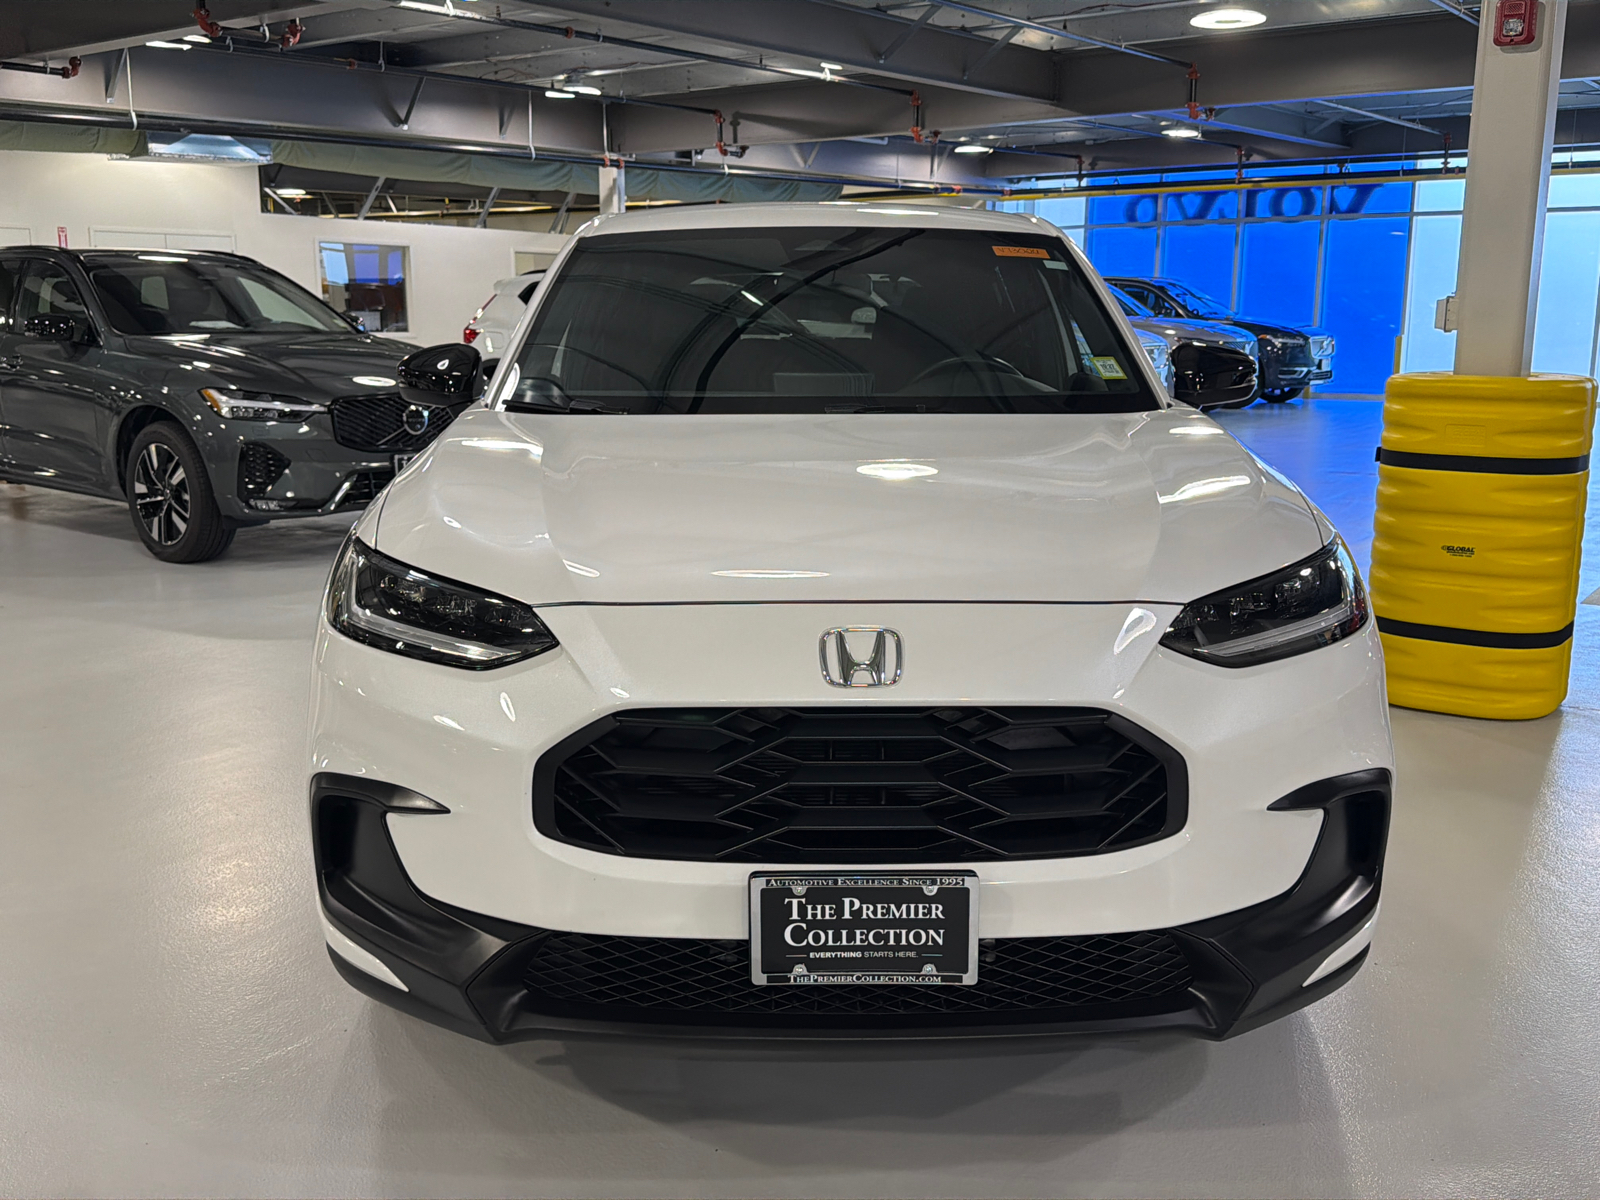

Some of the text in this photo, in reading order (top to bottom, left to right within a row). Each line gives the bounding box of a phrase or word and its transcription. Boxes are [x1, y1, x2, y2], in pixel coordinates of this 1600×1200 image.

[768, 878, 963, 887] AUTOMOTIVE EXCELLENCE SINCE 1995
[784, 897, 945, 920] THE PREMIER
[784, 922, 945, 947] COLLECTION
[788, 974, 941, 983] THEPREMIERCOLLECTION.COM
